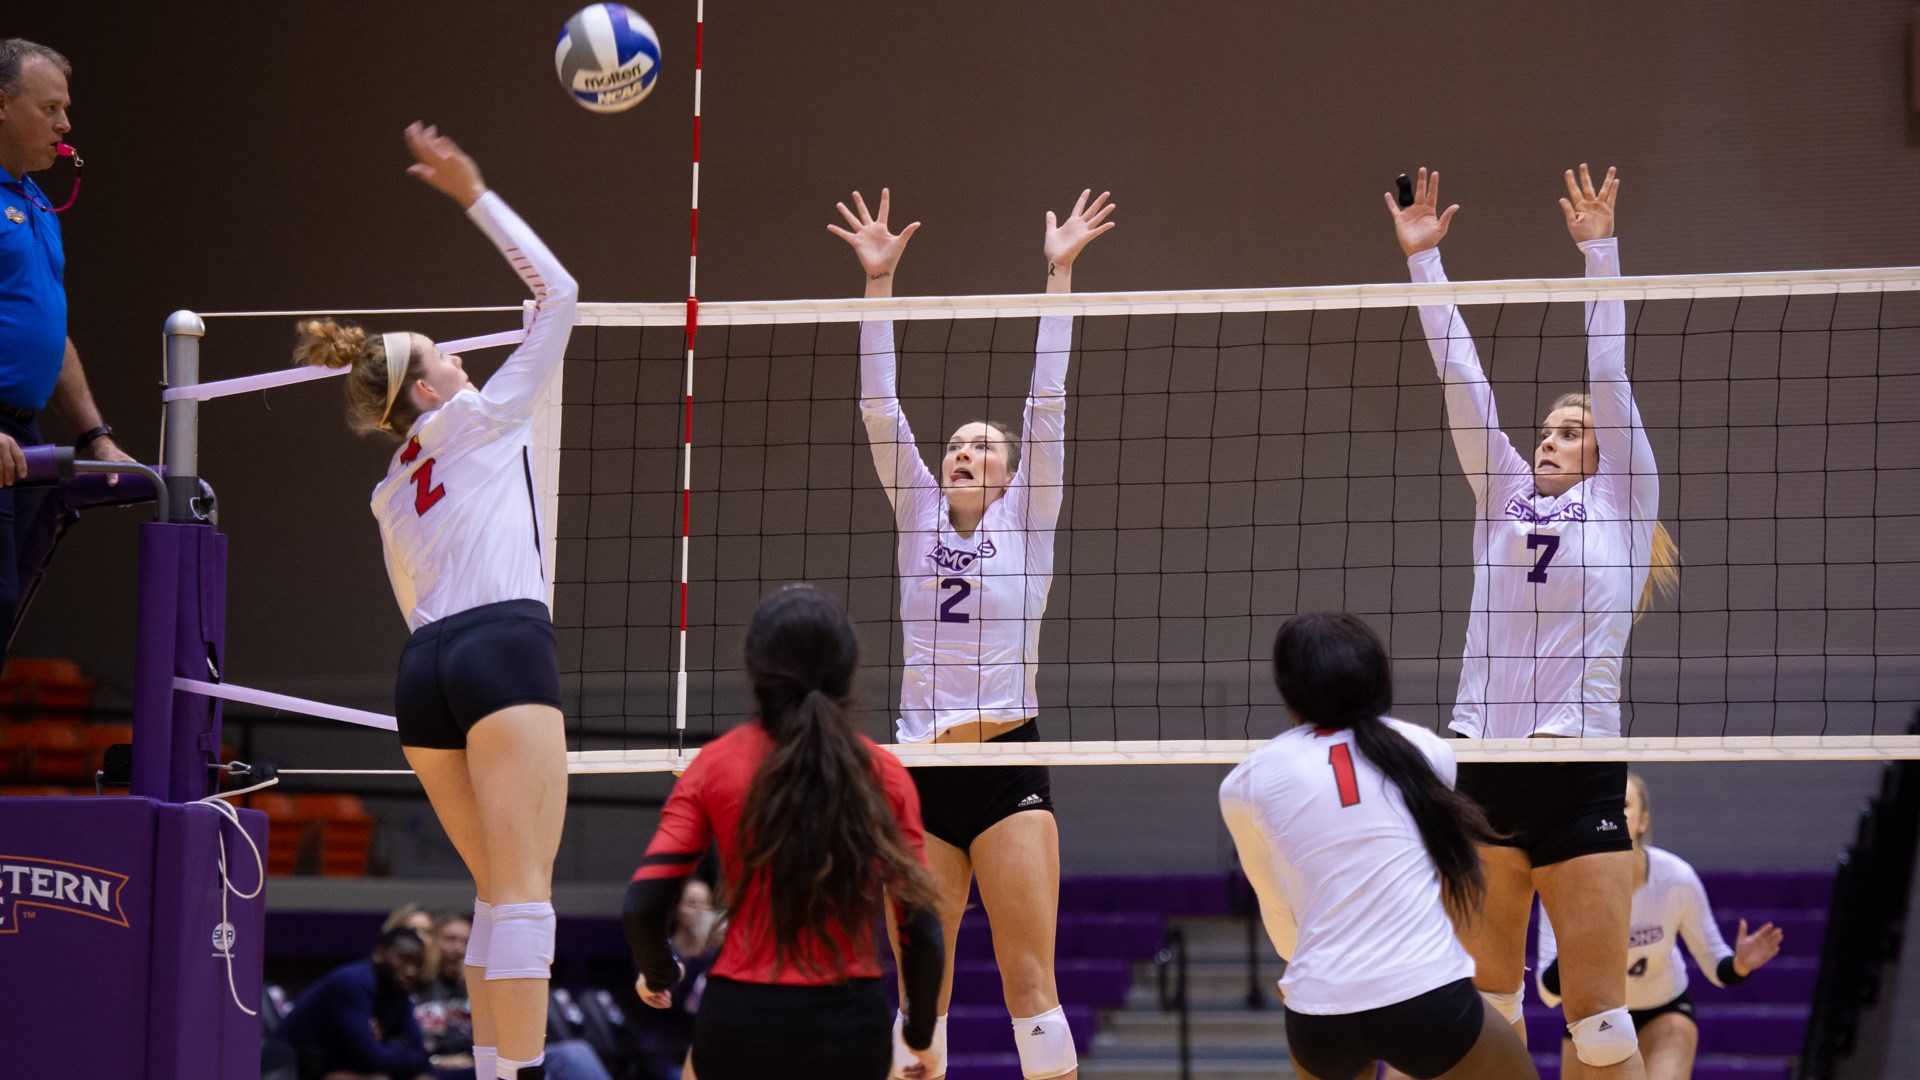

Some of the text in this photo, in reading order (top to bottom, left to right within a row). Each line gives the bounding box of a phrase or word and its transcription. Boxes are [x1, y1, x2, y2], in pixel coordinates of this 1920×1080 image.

[584, 64, 641, 89] molten
[410, 457, 446, 517] 2
[1526, 533, 1560, 584] 7
[940, 578, 971, 623] 2
[1328, 742, 1361, 808] 1
[1627, 957, 1648, 977] 4
